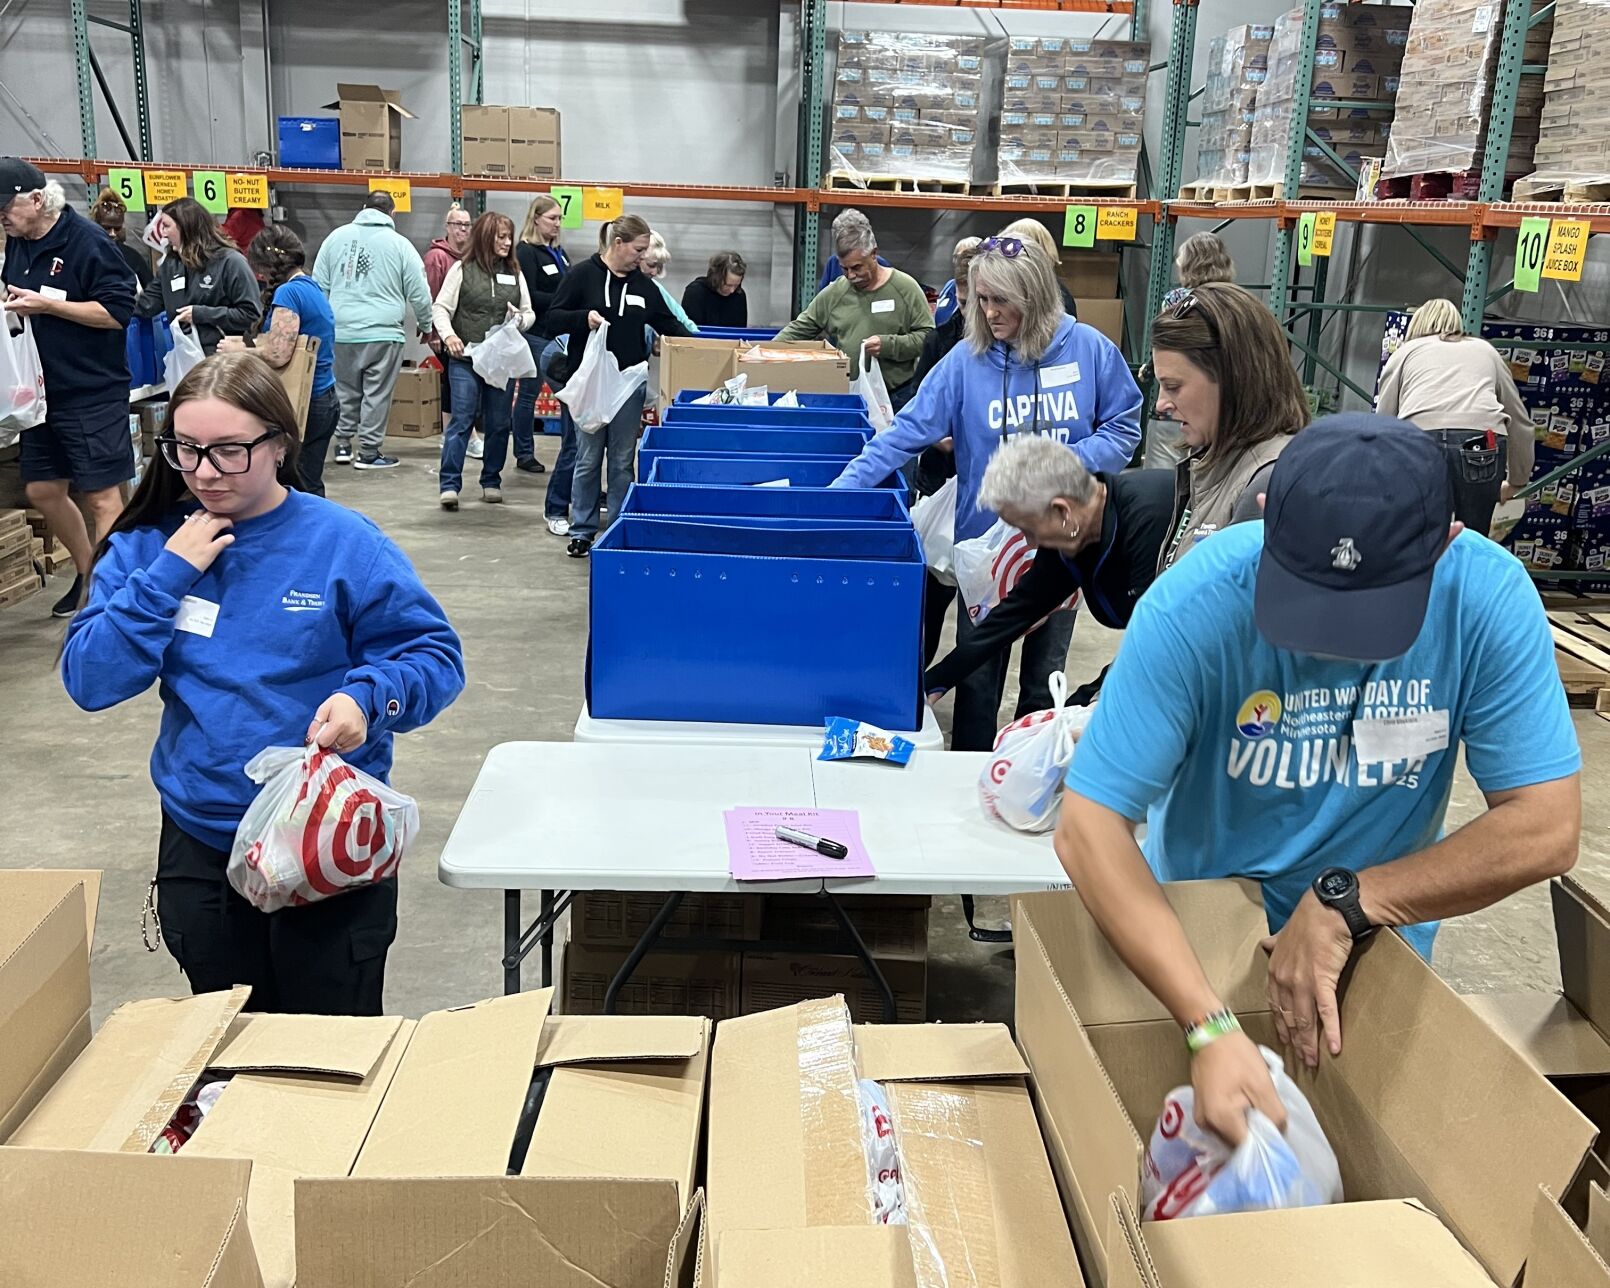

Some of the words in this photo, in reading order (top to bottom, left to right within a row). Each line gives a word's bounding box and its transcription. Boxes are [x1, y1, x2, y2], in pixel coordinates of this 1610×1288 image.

[121, 178, 133, 199] 5
[246, 178, 259, 186] NUT
[204, 179, 216, 201] 6
[233, 187, 260, 195] BUTTER
[233, 196, 261, 205] CREAMY
[561, 195, 572, 216] 7
[1074, 213, 1086, 235] 8
[1099, 219, 1134, 227] CRACKERS
[1302, 223, 1309, 250] 9
[1557, 225, 1581, 239] MANGO
[1521, 231, 1542, 270] 10
[1552, 242, 1578, 256] SPLASH
[1545, 258, 1563, 271] JUICE
[1562, 260, 1579, 273] BOX
[1533, 327, 1548, 338] 36
[1593, 331, 1608, 342] 36
[1569, 397, 1584, 408] 36
[988, 390, 1080, 431] CAPTIVA
[1553, 531, 1568, 541] 36
[1363, 679, 1402, 706] DAY
[1407, 678, 1431, 706] OF
[1284, 687, 1331, 713] UNITED
[1282, 709, 1353, 728] Noheastern
